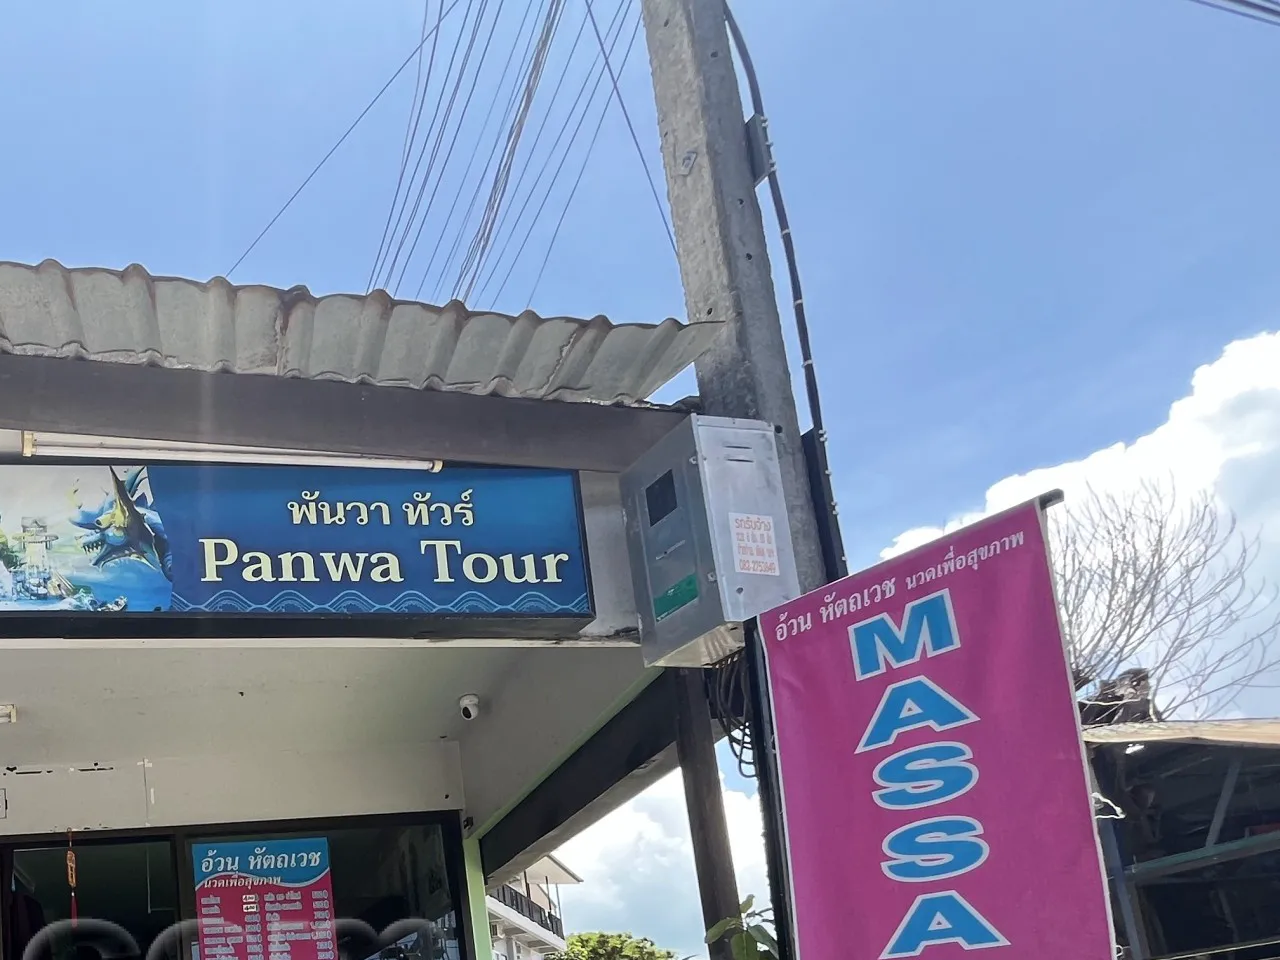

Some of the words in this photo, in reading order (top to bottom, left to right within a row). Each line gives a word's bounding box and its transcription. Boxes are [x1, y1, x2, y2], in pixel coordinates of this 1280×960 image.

[287, 490, 391, 526] พันวา
[402, 489, 475, 527] ทัวร์
[198, 538, 405, 583] Panwa
[419, 540, 569, 583] Tour
[775, 612, 813, 642] อ้วน
[819, 575, 896, 625] หัตถเวช
[905, 531, 1025, 590] นวดเพื่อสุขภาพ
[202, 849, 239, 872] อ้วน
[248, 847, 321, 870] หัตถเวช
